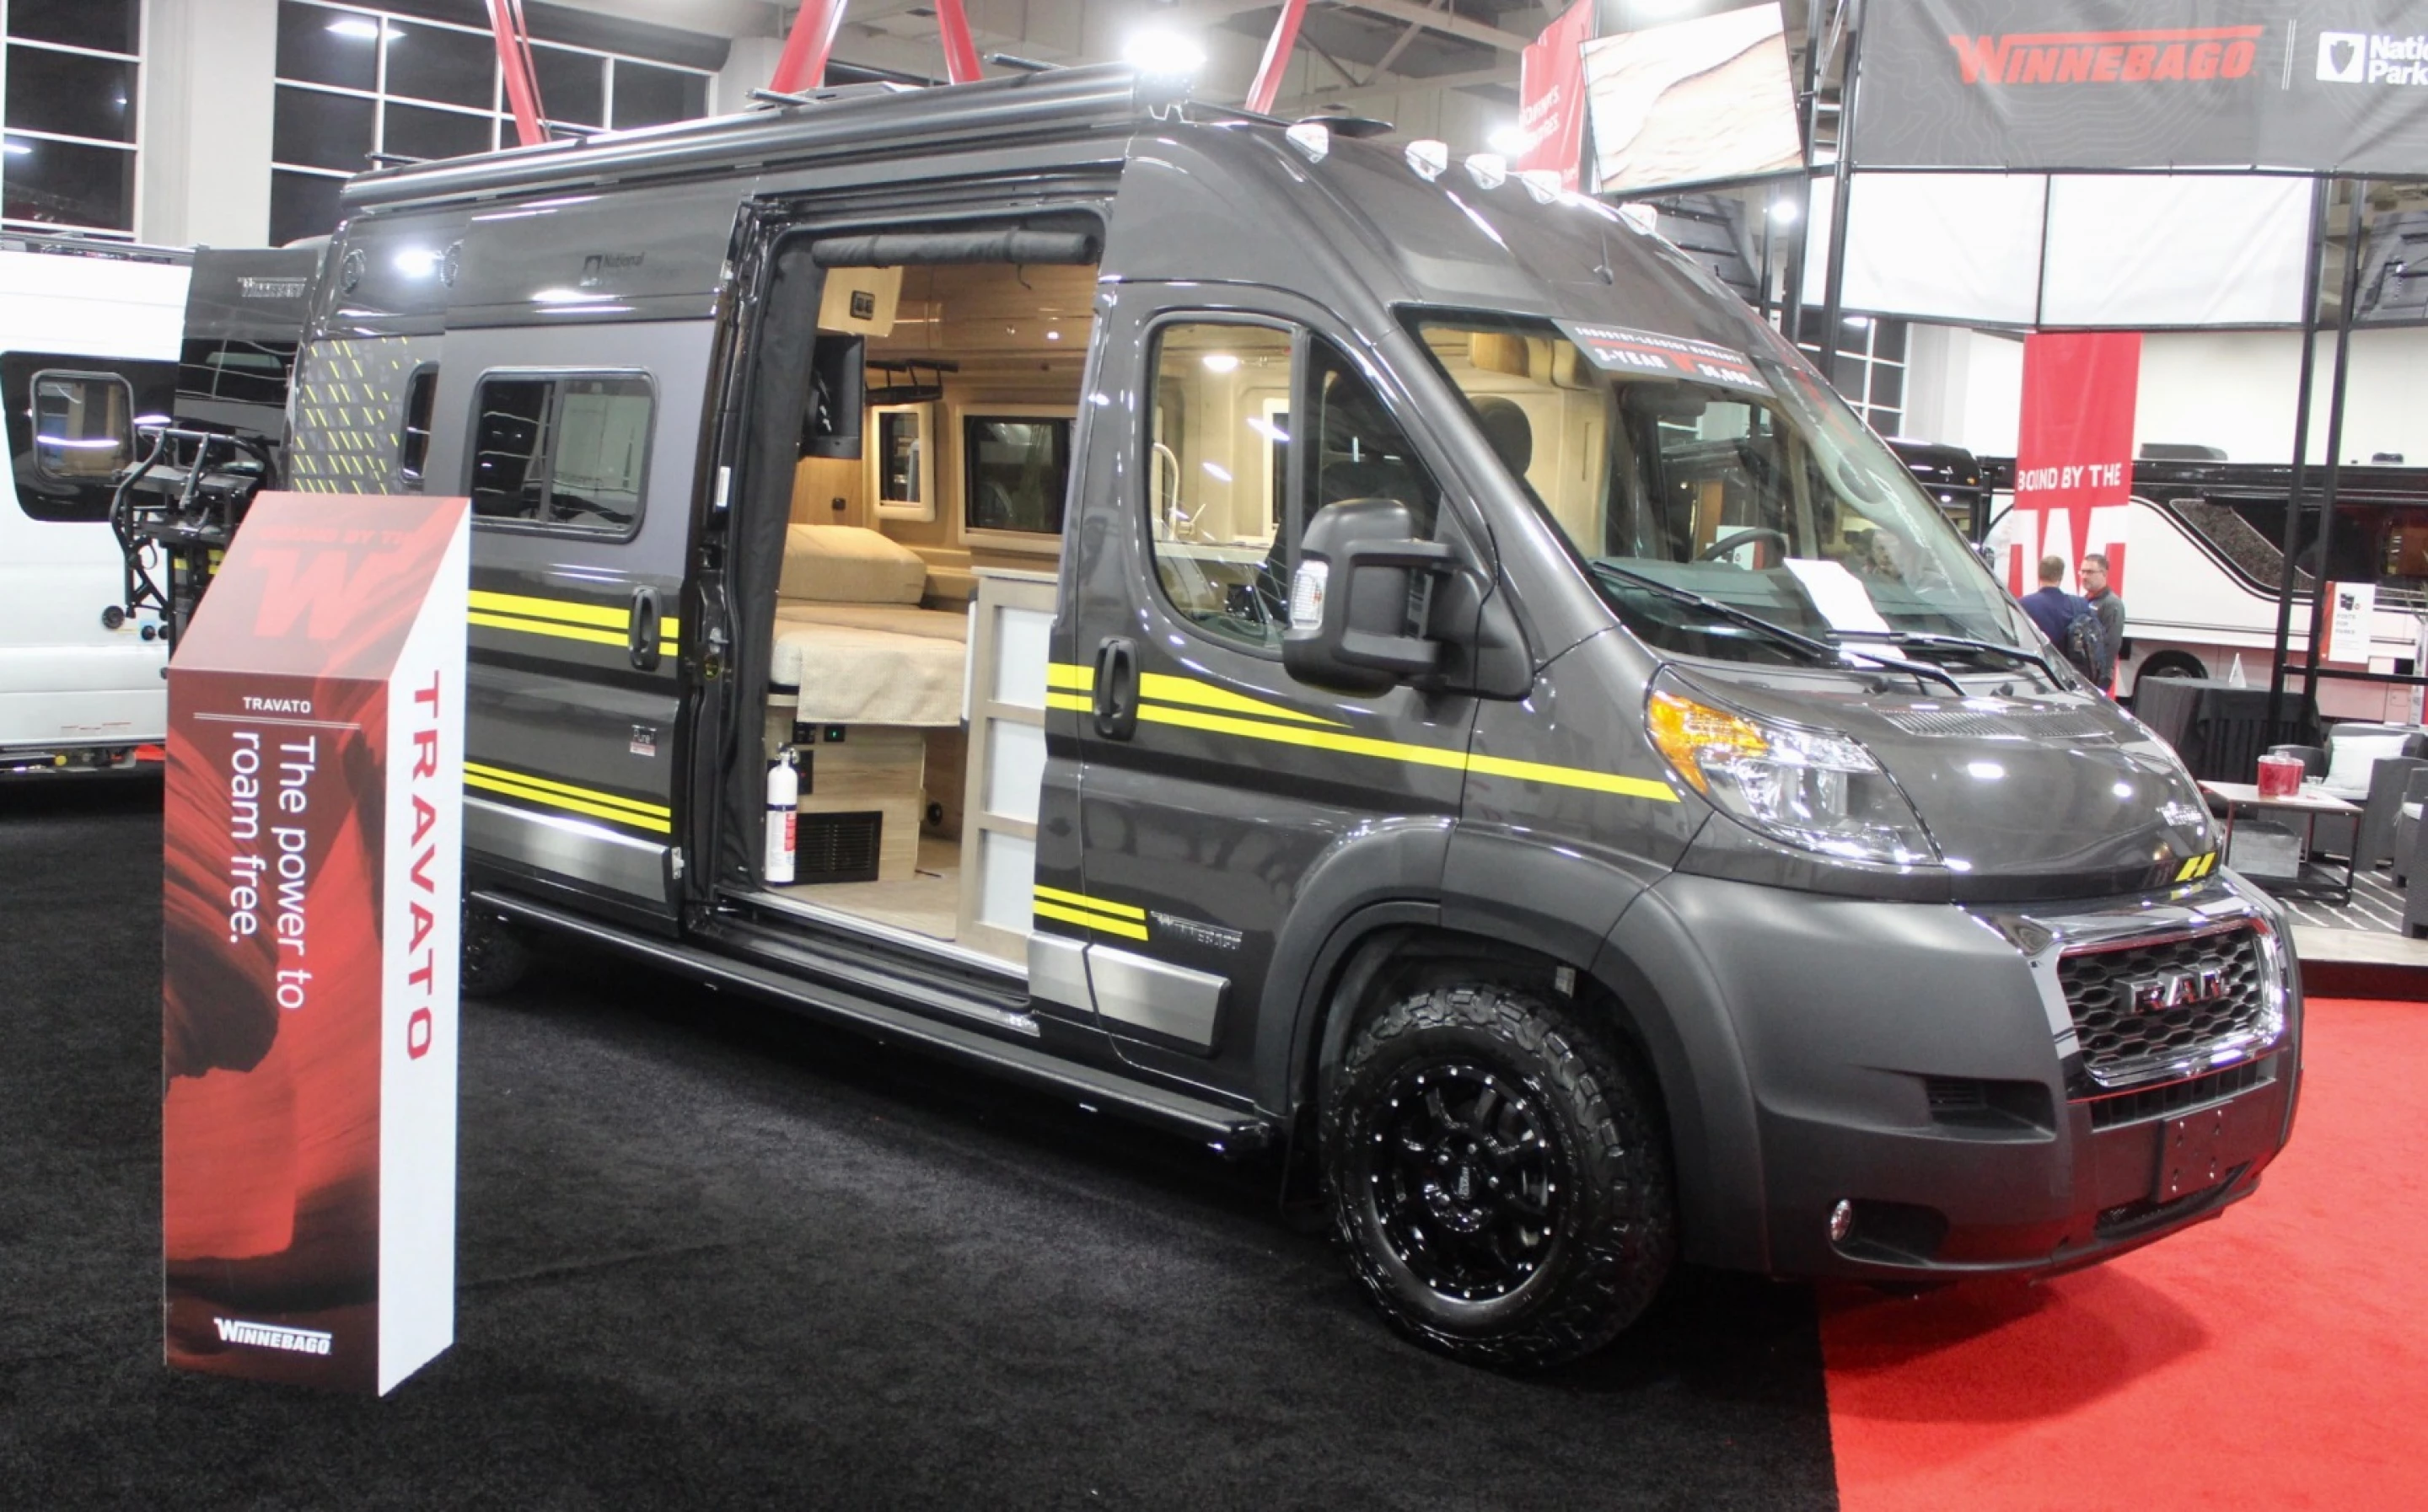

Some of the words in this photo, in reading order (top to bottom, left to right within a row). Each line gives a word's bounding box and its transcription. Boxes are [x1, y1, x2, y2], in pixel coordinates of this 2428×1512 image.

[1949, 24, 2264, 85] WINNEBAGO
[2060, 465, 2085, 489] BY
[2089, 463, 2123, 488] THE
[242, 696, 312, 714] TRAVATO
[231, 732, 260, 840] roam
[278, 735, 315, 813] The
[270, 827, 307, 956] power
[406, 669, 440, 1061] TRAVATO
[229, 854, 268, 944] free.
[277, 968, 313, 1010] to
[2123, 969, 2230, 1013] RAM
[213, 1316, 332, 1355] WINNEBAGO
